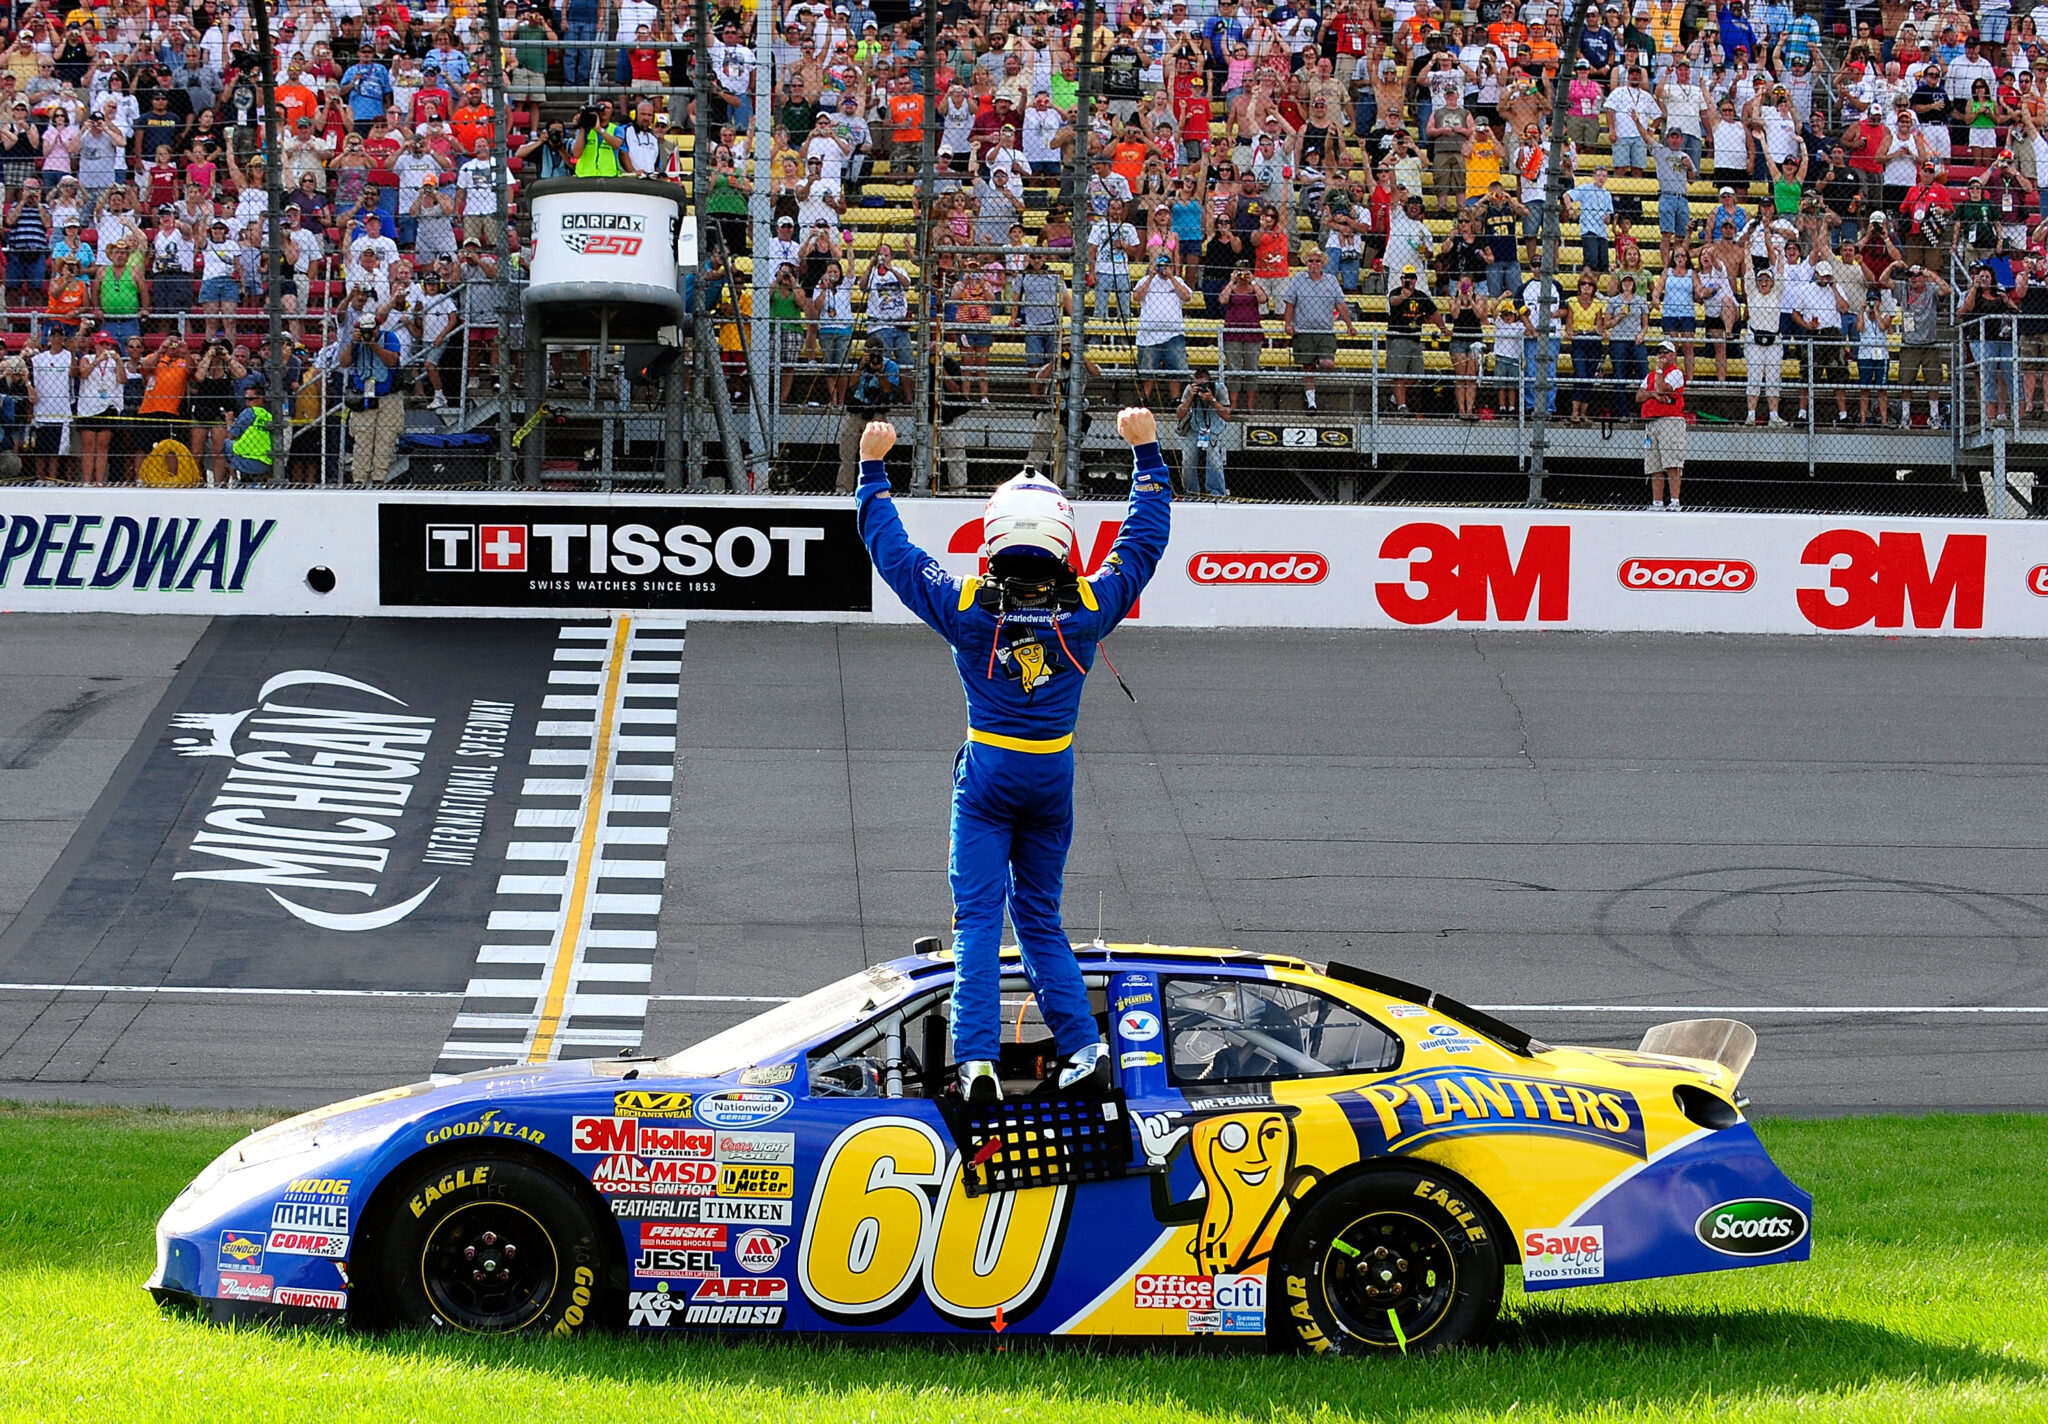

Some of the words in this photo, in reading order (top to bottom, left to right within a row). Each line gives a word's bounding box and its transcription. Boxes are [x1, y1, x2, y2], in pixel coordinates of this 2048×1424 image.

[562, 214, 644, 232] CARFAX
[584, 235, 643, 256] 250
[1295, 430, 1306, 445] 2
[0, 514, 277, 593] PEEDWAY
[532, 524, 825, 577] TISSOT
[1197, 555, 1319, 581] bondo
[1374, 522, 1571, 625] 3M
[1627, 563, 1747, 588] bondo
[529, 580, 571, 590] SWISS
[577, 580, 637, 591] WATCHES
[643, 581, 682, 592] SINCE
[688, 582, 717, 592] 1853
[1795, 529, 1988, 630] 3M
[455, 699, 515, 758] SPEEDWAY
[172, 702, 436, 897] MICHIGAN
[422, 765, 498, 866] INTERNATIONAL
[1419, 1038, 1447, 1050] World
[1447, 1037, 1482, 1046] Financial
[1445, 1045, 1471, 1053] Group
[741, 1093, 776, 1101] NASCAR
[615, 1107, 664, 1118] MECHANIX
[664, 1108, 692, 1119] WEAR
[714, 1102, 778, 1112] Nationwide
[1355, 1076, 1631, 1141] PLANTERS
[425, 1119, 546, 1144] GOODYEAR
[575, 1118, 637, 1152] 3M
[641, 1129, 713, 1158] Holley
[721, 1138, 752, 1152] Coors
[752, 1142, 789, 1152] LIGHT
[660, 1149, 700, 1157] CARBS
[728, 1152, 779, 1161] POLE
[593, 1154, 650, 1181] MAC
[652, 1161, 718, 1184] MSD
[739, 1168, 780, 1181] Auto
[284, 1179, 351, 1195] MOOG
[409, 1166, 490, 1218] EAGLE
[592, 1181, 651, 1193] TOOLS
[650, 1182, 713, 1196] IGNITION
[734, 1180, 788, 1193] Meter
[274, 1204, 347, 1228] MAHLE
[611, 1200, 699, 1218] FEATHERLITE
[705, 1203, 784, 1220] TIMKEN
[797, 1115, 1068, 1320] 60
[1413, 1179, 1488, 1243] EAGLE
[649, 1226, 719, 1239] PENSKE
[1711, 1213, 1792, 1240] Scotts
[223, 1244, 260, 1255] SUNOCO
[271, 1233, 329, 1250] COMP
[655, 1239, 681, 1247] RACING
[683, 1240, 712, 1248] SHOCKS
[1526, 1233, 1597, 1257] Save
[636, 1251, 715, 1272] JESEL
[694, 1271, 718, 1279] LIFTERS
[1529, 1269, 1558, 1278] FOOD
[1561, 1266, 1600, 1276] STORES
[220, 1278, 272, 1298] Raybestos
[697, 1279, 787, 1296] ARP
[1135, 1275, 1211, 1295] Office
[279, 1291, 340, 1309] SIMPSON
[1135, 1295, 1211, 1309] DEPOT
[685, 1306, 783, 1324] MOROSO
[1189, 1315, 1219, 1323] CHAMPION
